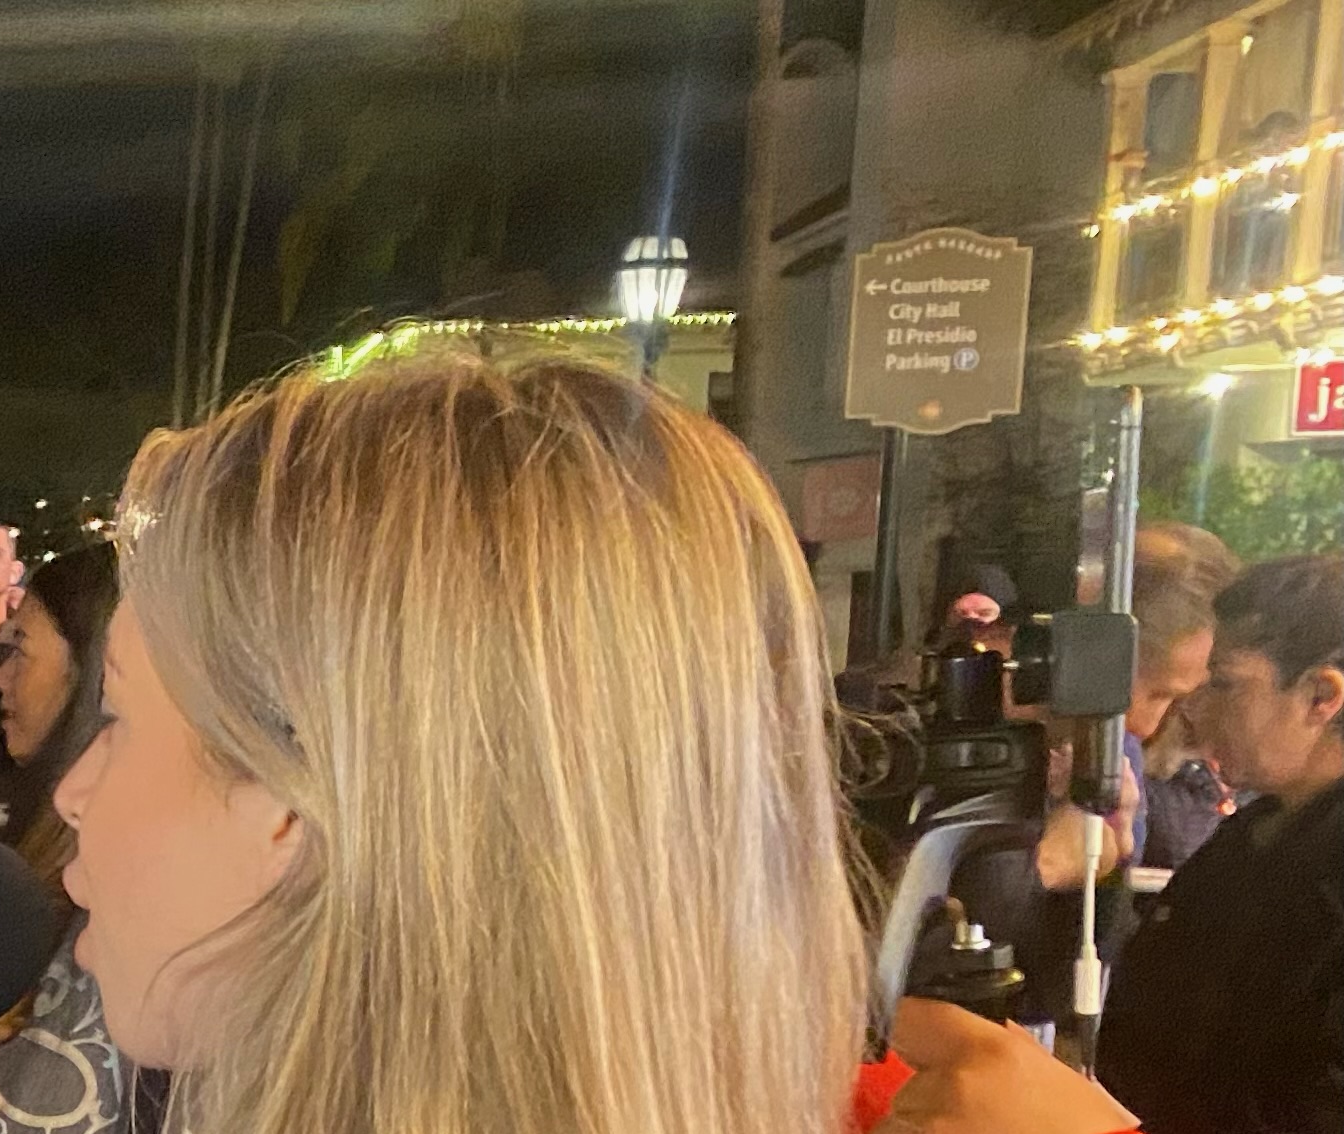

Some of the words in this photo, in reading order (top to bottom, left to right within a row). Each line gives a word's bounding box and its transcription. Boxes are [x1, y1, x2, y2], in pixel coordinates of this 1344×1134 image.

[890, 276, 990, 294] Courthouse
[889, 303, 922, 323] City
[925, 301, 960, 318] Hall
[887, 328, 902, 345] El
[906, 326, 977, 344] Presidio
[886, 352, 951, 373] Parking
